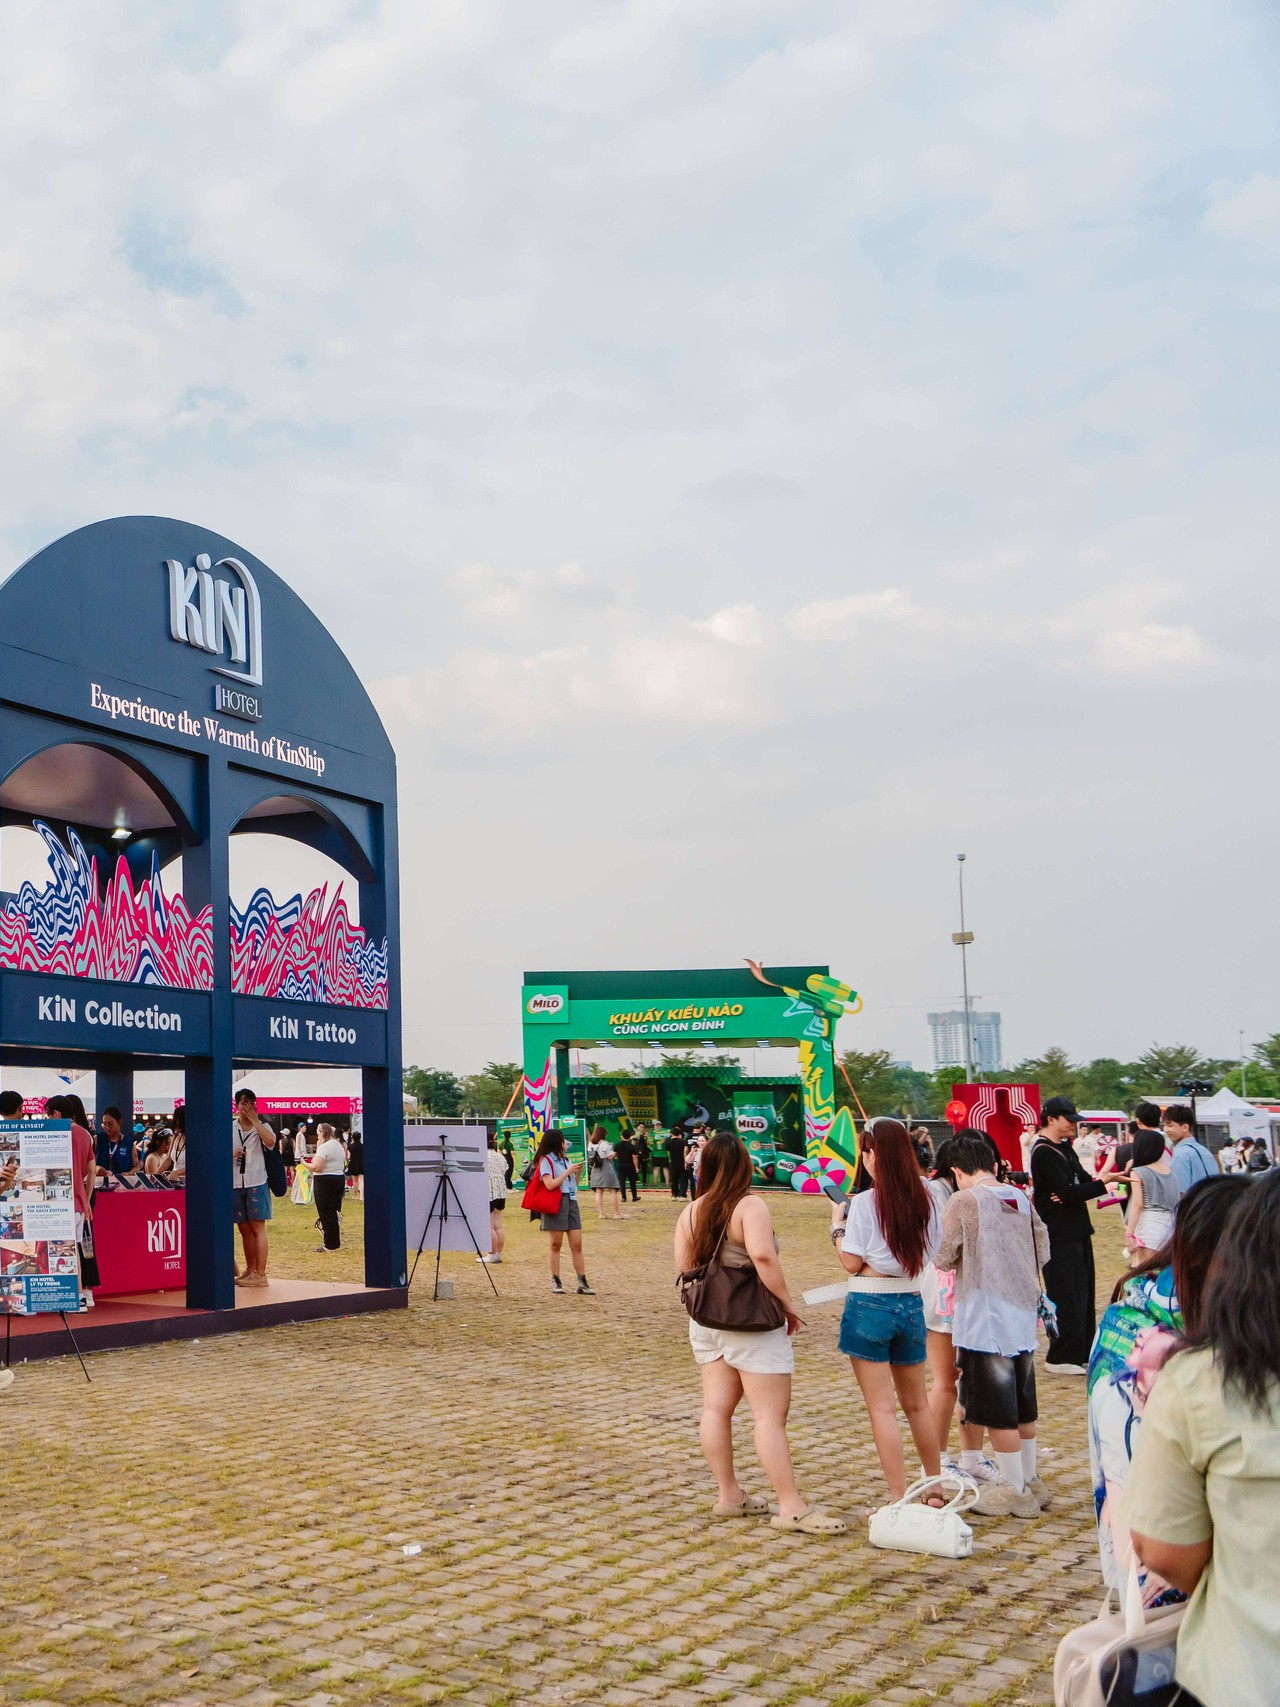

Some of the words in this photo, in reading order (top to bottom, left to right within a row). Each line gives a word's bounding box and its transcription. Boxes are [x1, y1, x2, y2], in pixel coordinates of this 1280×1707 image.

[222, 687, 263, 718] HOTEL
[90, 682, 176, 730] Experience
[177, 710, 201, 737] the
[203, 716, 260, 754] Warmth
[261, 736, 277, 758] of
[276, 739, 326, 777] KinShip
[38, 994, 76, 1023] KiN
[84, 1000, 182, 1032] Collection
[533, 1000, 560, 1009] MILO
[609, 1006, 665, 1025] KHUẤY
[707, 1003, 744, 1018] NÀO
[270, 1015, 299, 1039] KiN
[305, 1019, 357, 1044] Tattoo
[612, 1022, 648, 1035] CŨNG
[651, 1021, 688, 1033] NGON
[266, 1101, 291, 1109] THREE
[292, 1101, 328, 1109] O'CLOCK
[738, 1120, 765, 1128] MILO
